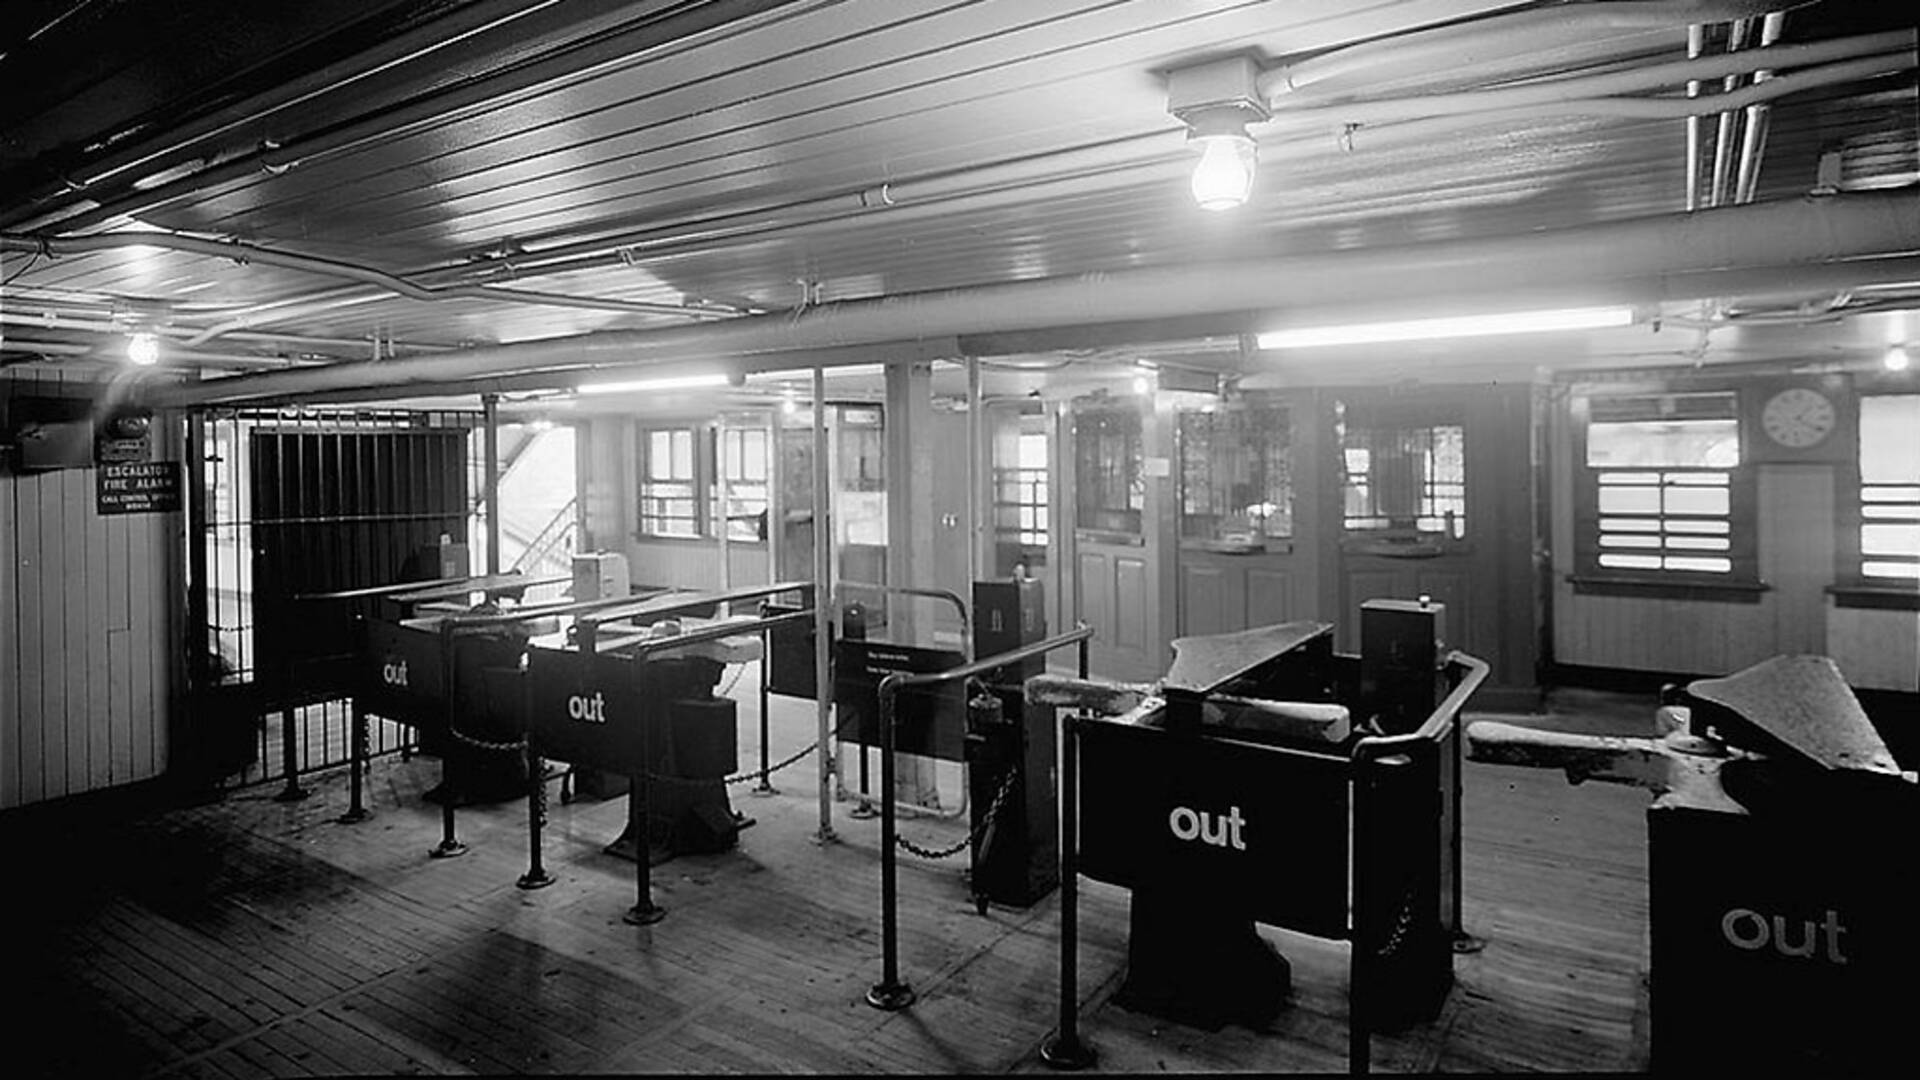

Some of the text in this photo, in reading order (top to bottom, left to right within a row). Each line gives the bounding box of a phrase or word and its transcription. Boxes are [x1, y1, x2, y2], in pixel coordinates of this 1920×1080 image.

[104, 479, 128, 490] FIRE
[384, 660, 408, 686] out
[569, 692, 605, 723] out
[1169, 806, 1246, 850] out
[1722, 908, 1847, 964] out
